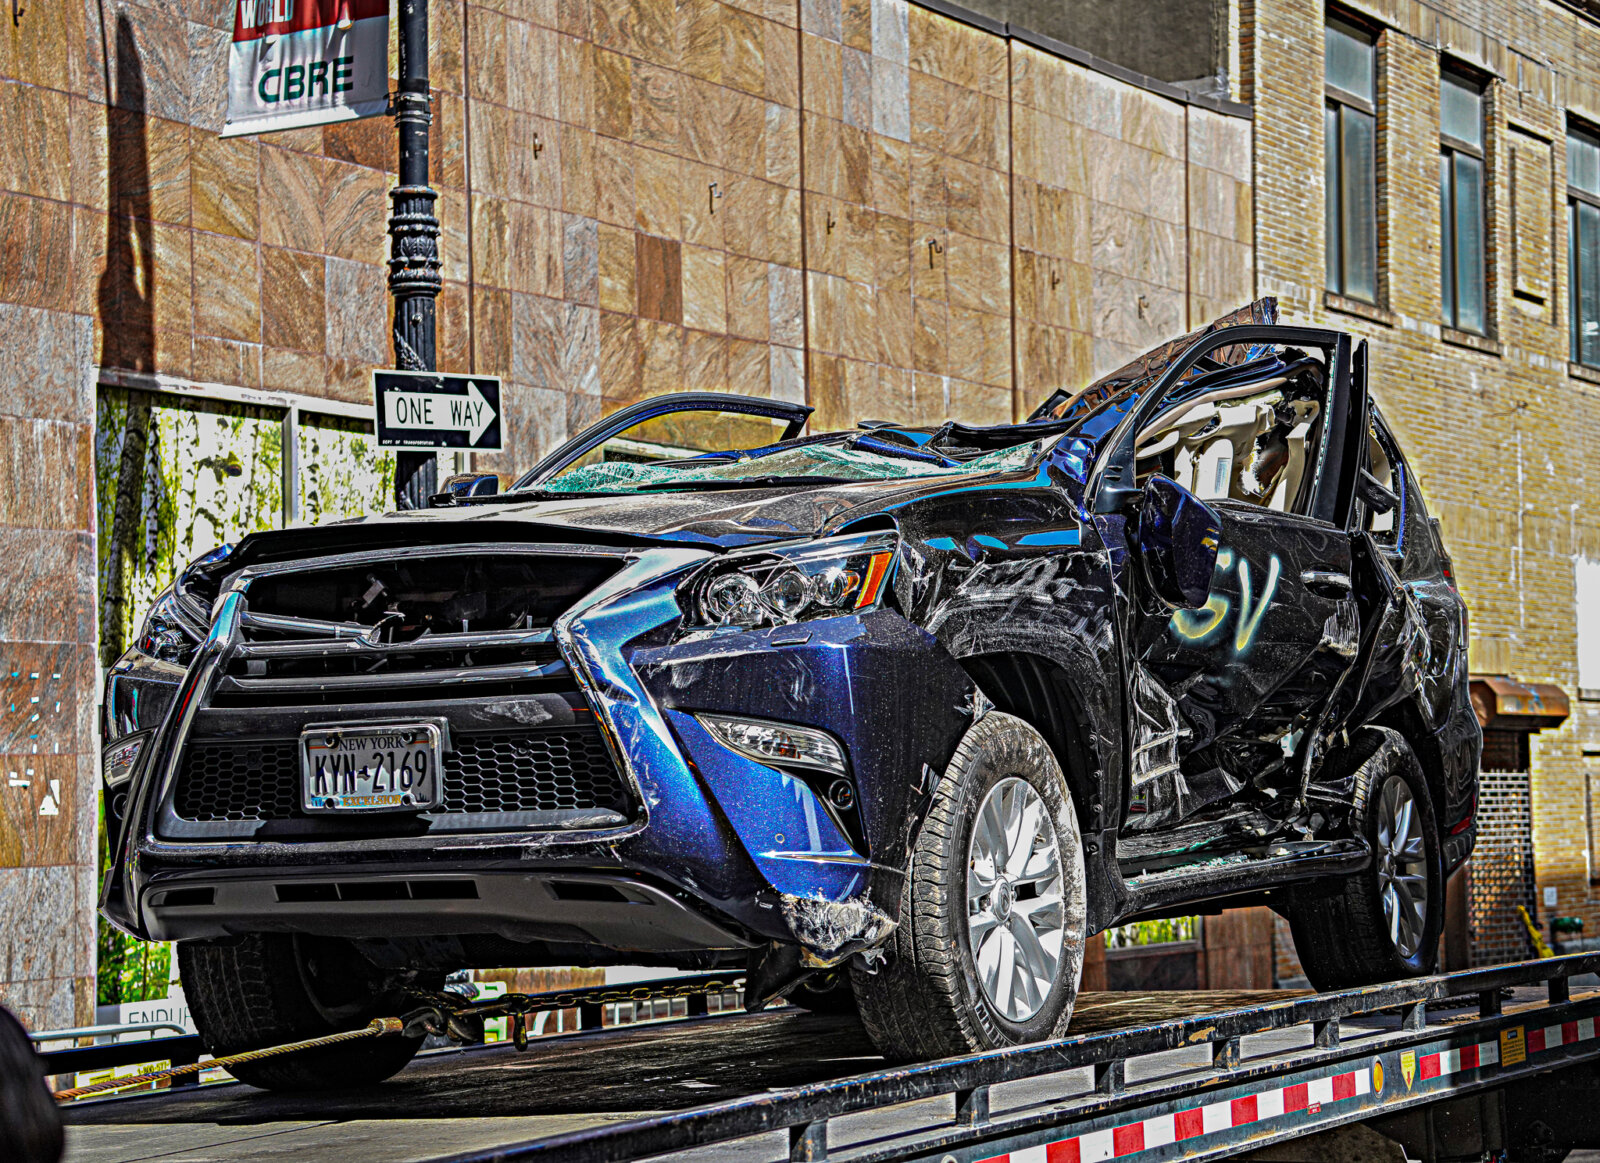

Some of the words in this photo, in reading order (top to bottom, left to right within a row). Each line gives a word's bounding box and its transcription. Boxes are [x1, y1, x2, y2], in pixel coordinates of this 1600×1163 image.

[241, 0, 294, 29] WORLD
[258, 55, 354, 103] CBRE
[396, 397, 434, 425] ONE
[450, 400, 483, 427] WAY
[339, 738, 367, 752] NEW
[369, 736, 405, 750] YORK
[342, 794, 402, 807] EXCELSIOR
